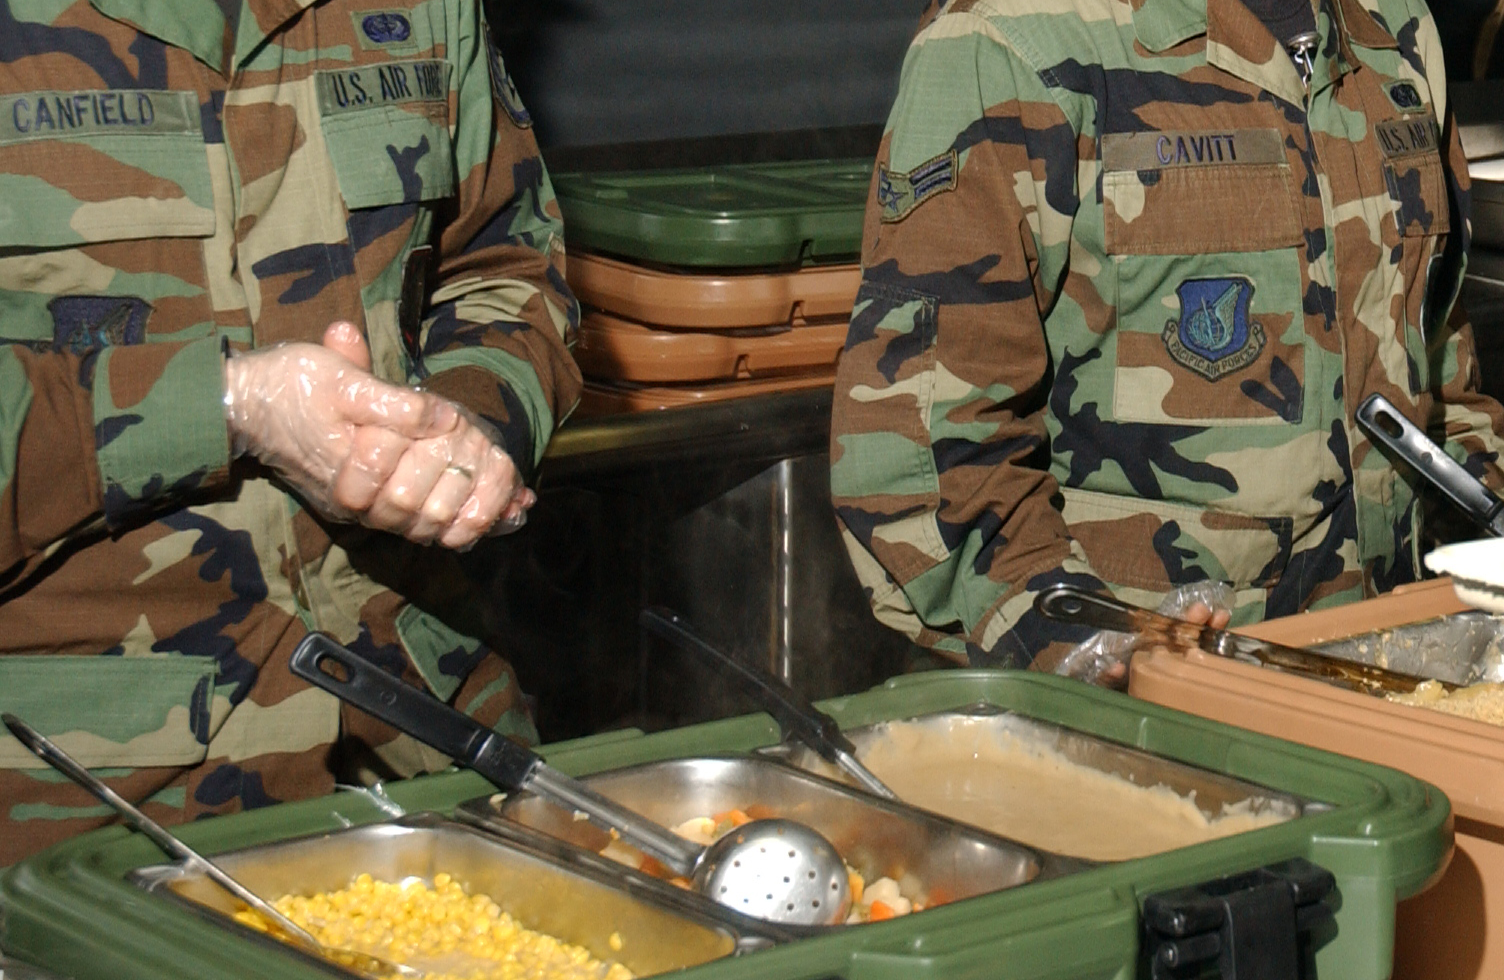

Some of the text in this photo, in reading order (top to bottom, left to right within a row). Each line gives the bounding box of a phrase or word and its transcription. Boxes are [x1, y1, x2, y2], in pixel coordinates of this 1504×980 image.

[332, 71, 374, 108] U.S.
[378, 65, 412, 100] AIR
[12, 92, 155, 133] CANFIELD
[1156, 134, 1237, 165] CAVITT
[1171, 341, 1257, 377] PACIFIC AIR FORCES
